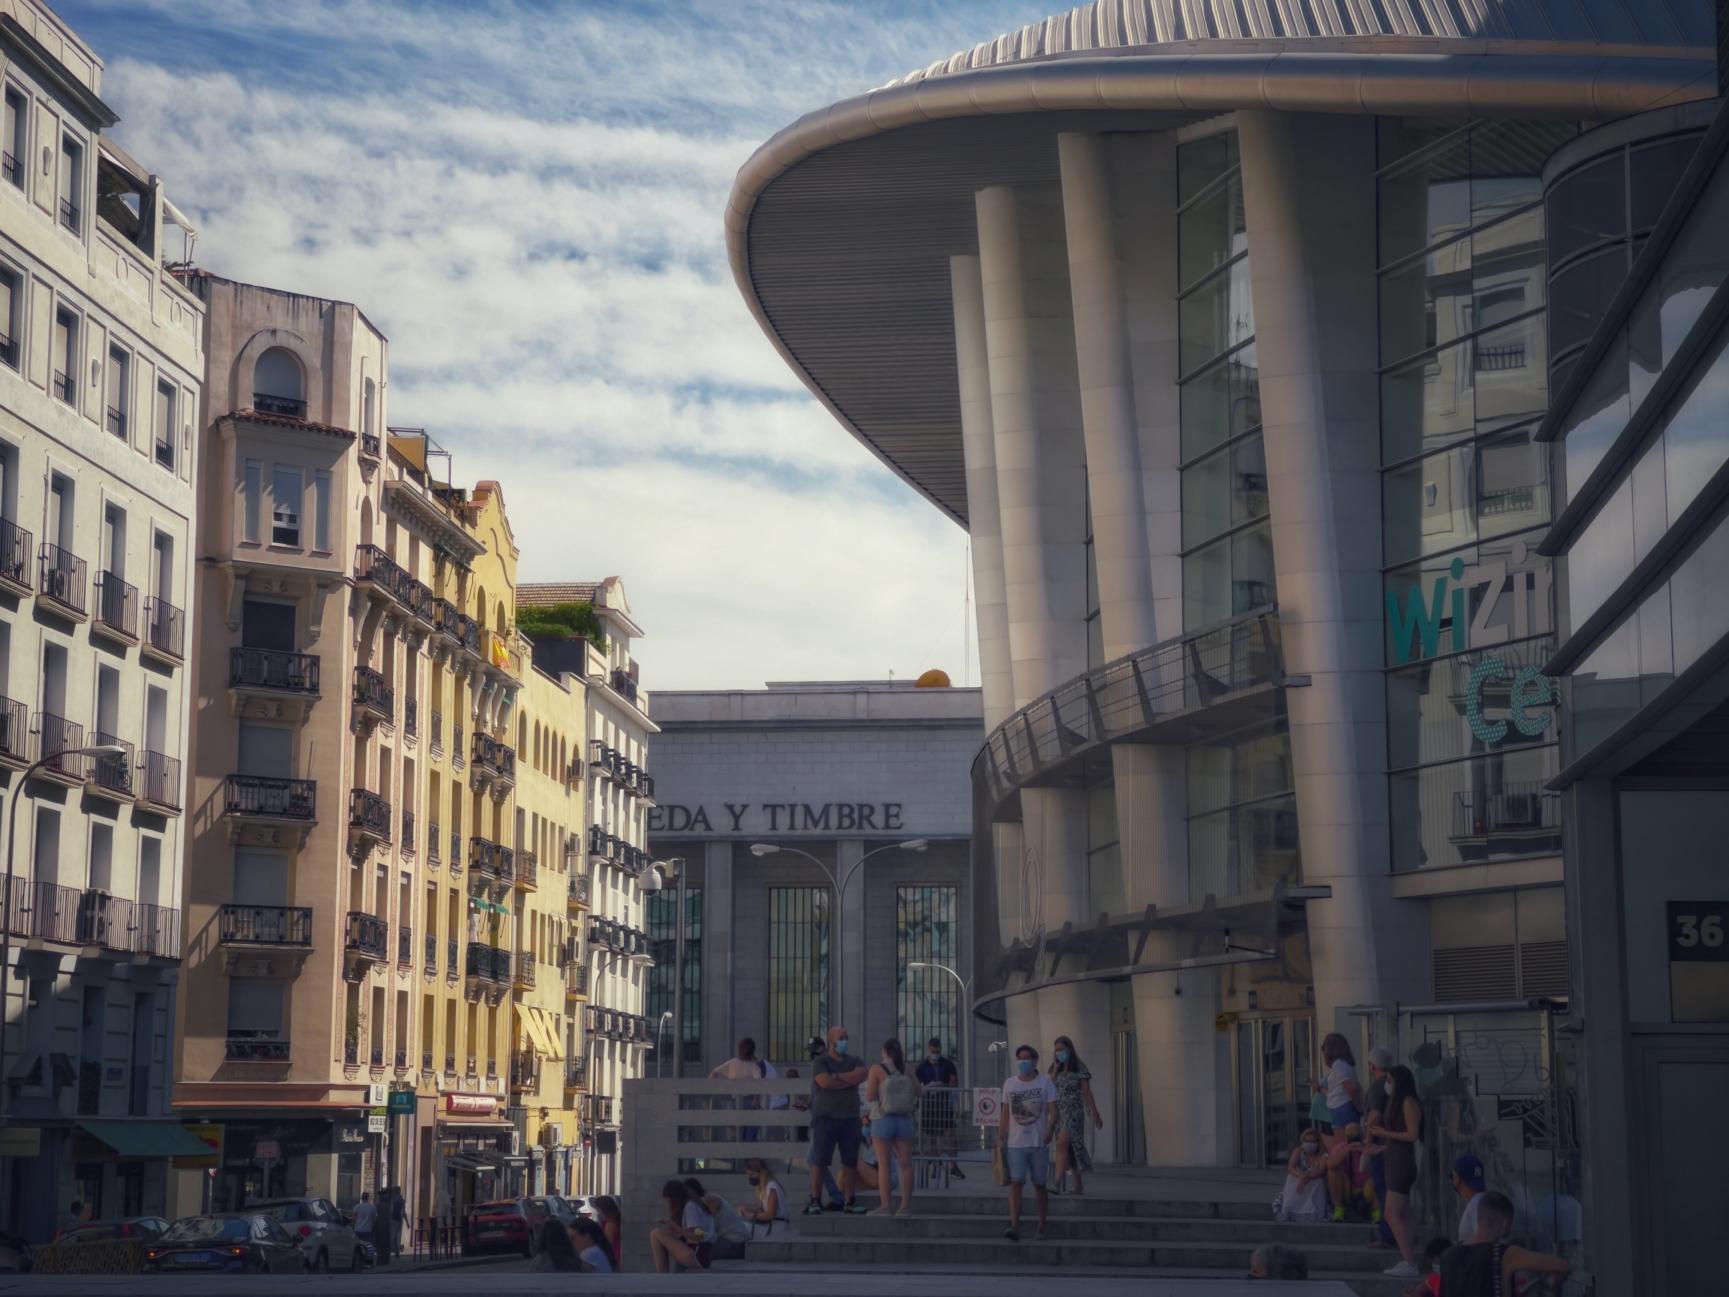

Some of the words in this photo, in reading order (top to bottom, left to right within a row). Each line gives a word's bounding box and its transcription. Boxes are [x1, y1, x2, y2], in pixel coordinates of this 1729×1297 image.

[724, 803, 750, 831] Y
[762, 802, 905, 831] TIMBRE
[1676, 914, 1725, 948] 36
